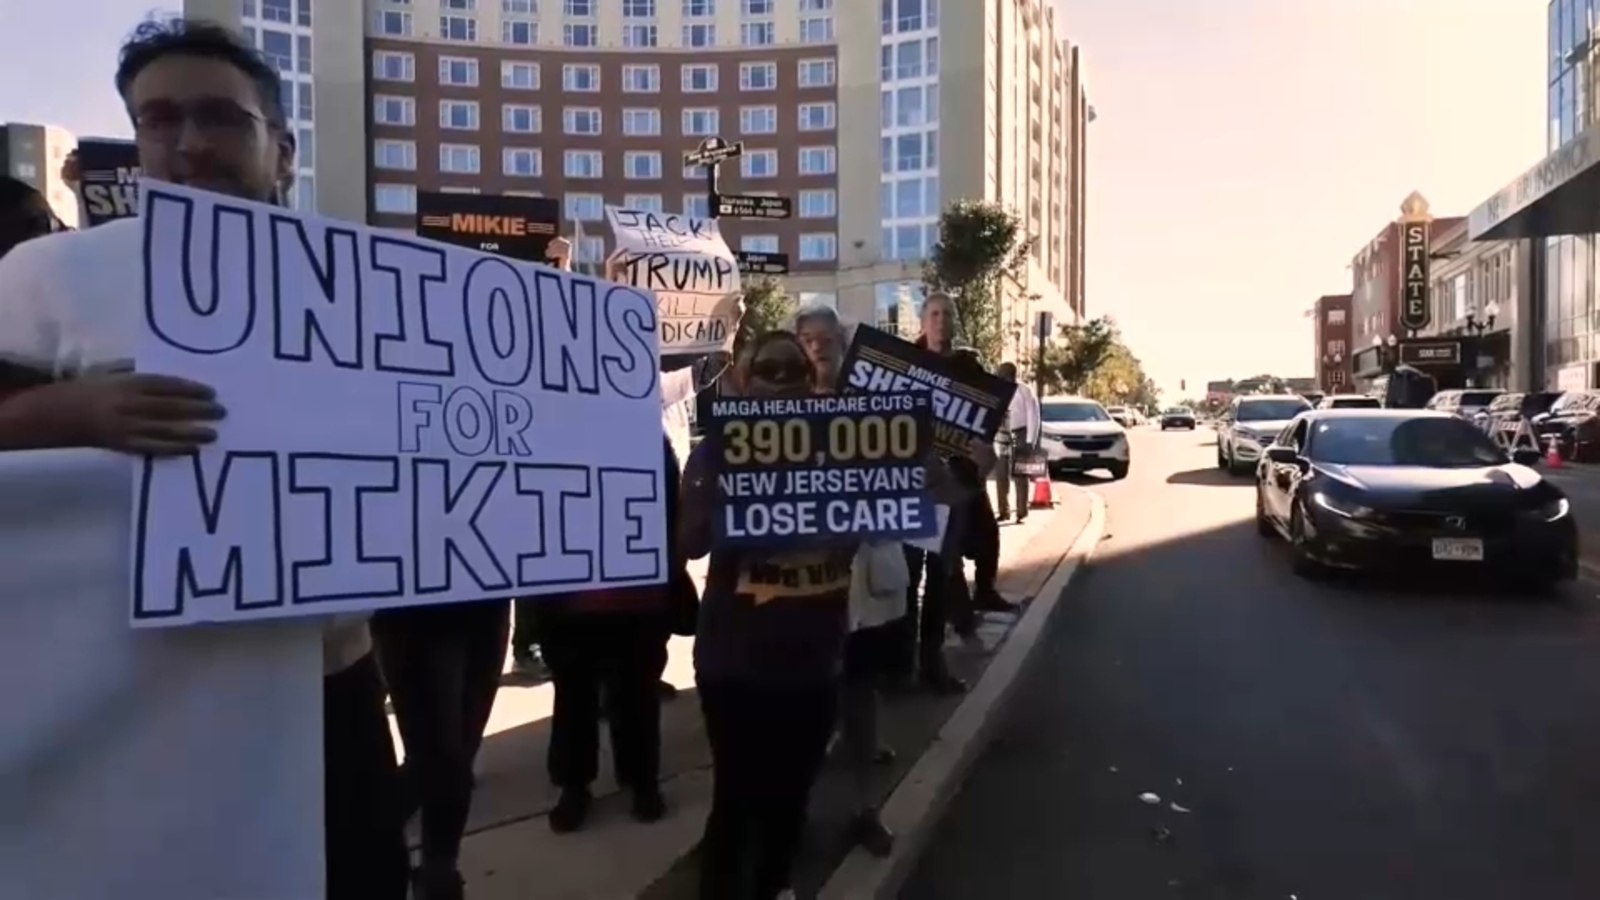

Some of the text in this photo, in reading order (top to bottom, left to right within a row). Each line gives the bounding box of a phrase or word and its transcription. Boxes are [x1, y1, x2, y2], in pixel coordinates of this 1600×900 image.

[452, 213, 526, 235] MIKIE
[625, 253, 732, 289] TRUMP
[1408, 227, 1425, 315] STATE
[145, 190, 657, 398] UNIONS
[661, 319, 725, 344] DICAID
[907, 364, 952, 390] MIKIE
[398, 382, 533, 456] FOR
[712, 401, 761, 417] MAGA
[764, 396, 867, 416] HEALTHCARE
[871, 395, 913, 411] CUTS
[723, 415, 918, 466] 390,000
[718, 466, 926, 497] NEW JERSEYANS
[133, 451, 659, 618] MIKIE
[725, 498, 922, 537] LOSE CARE
